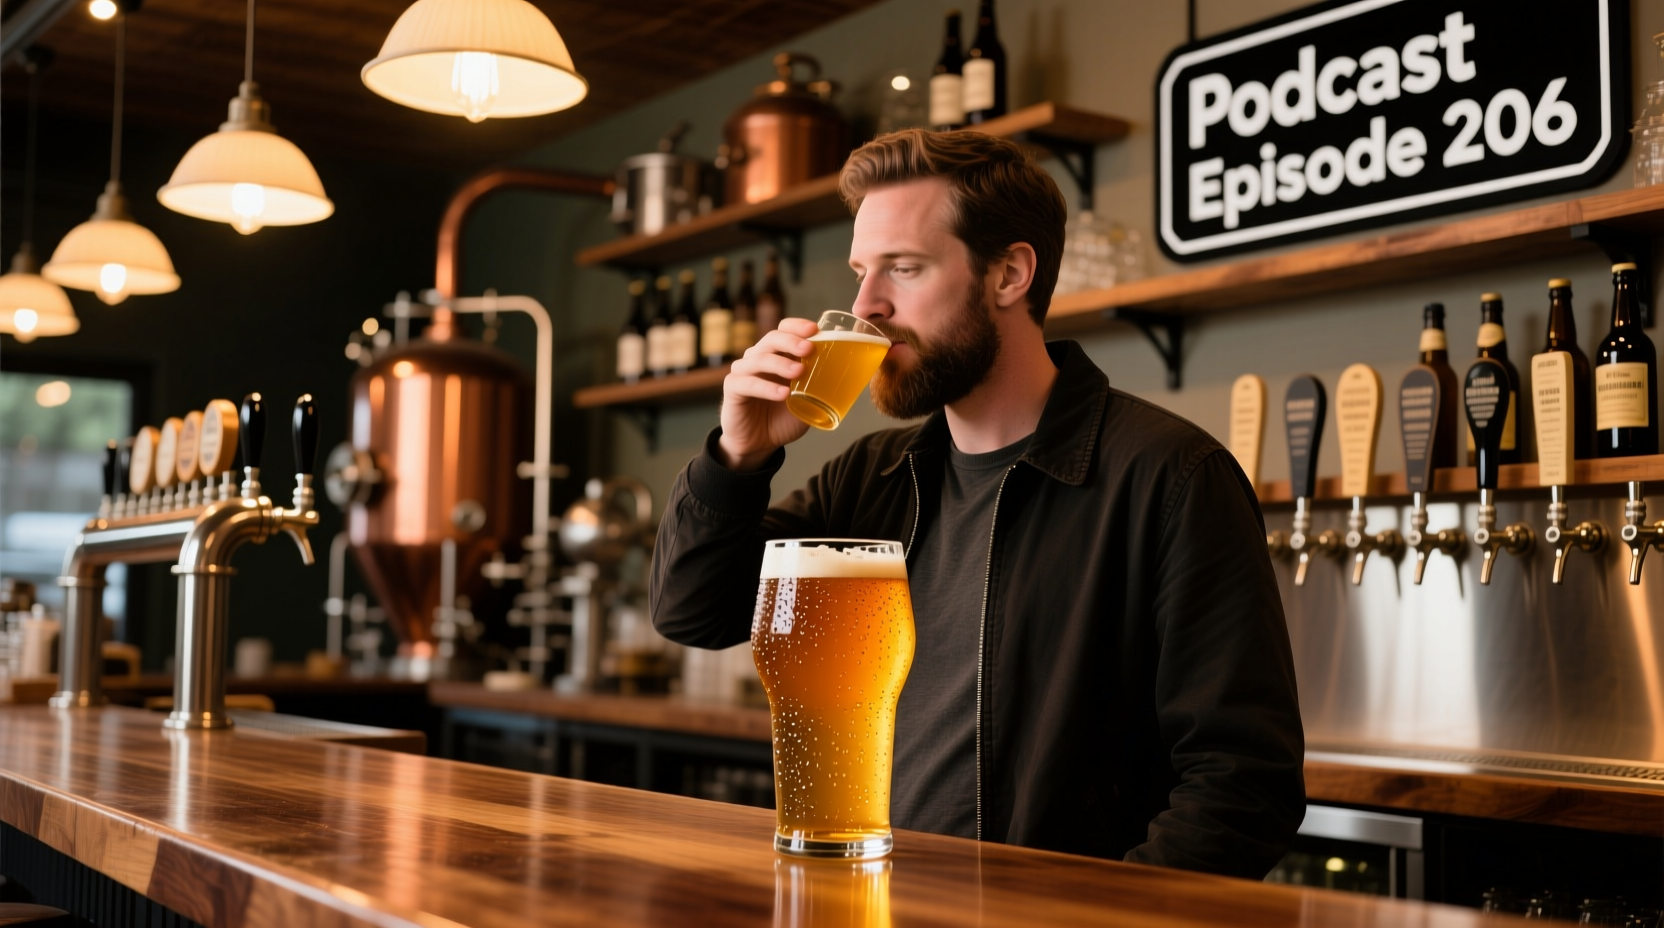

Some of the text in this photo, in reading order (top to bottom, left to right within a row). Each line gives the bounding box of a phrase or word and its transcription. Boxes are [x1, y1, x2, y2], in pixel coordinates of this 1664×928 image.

[1189, 11, 1476, 149] Podcast
[1189, 77, 1578, 229] Episode 206
